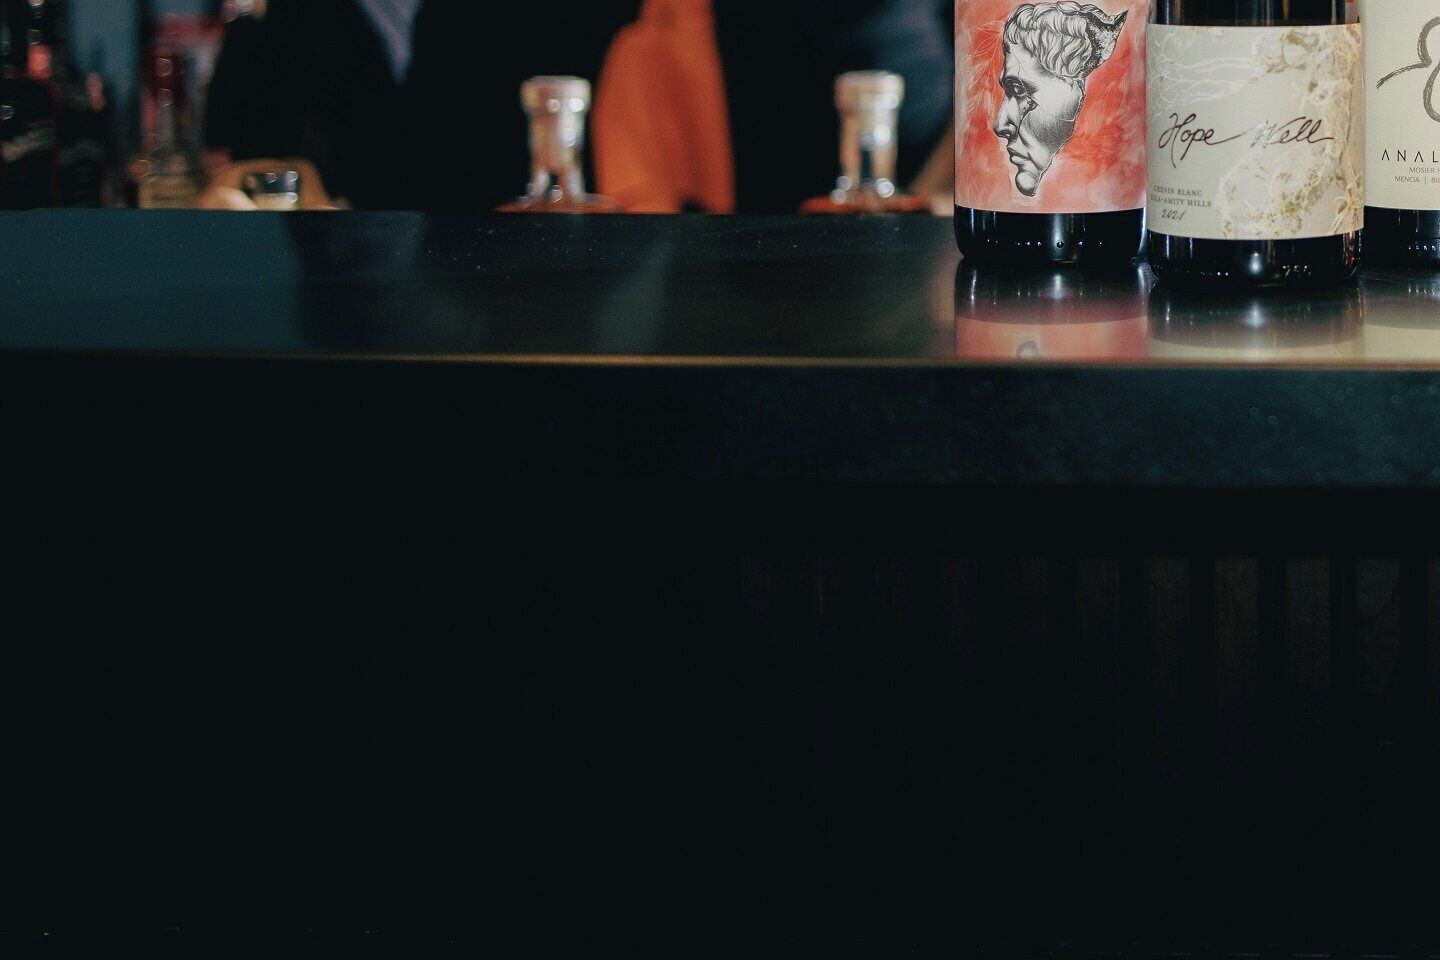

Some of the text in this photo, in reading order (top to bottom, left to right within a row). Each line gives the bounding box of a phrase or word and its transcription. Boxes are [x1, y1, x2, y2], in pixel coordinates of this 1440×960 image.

[1158, 112, 1246, 169] Hope
[1409, 166, 1436, 174] MOSIER
[1177, 188, 1203, 197] BLANC
[1187, 199, 1212, 208] HILLS
[1161, 208, 1186, 221] 2021
